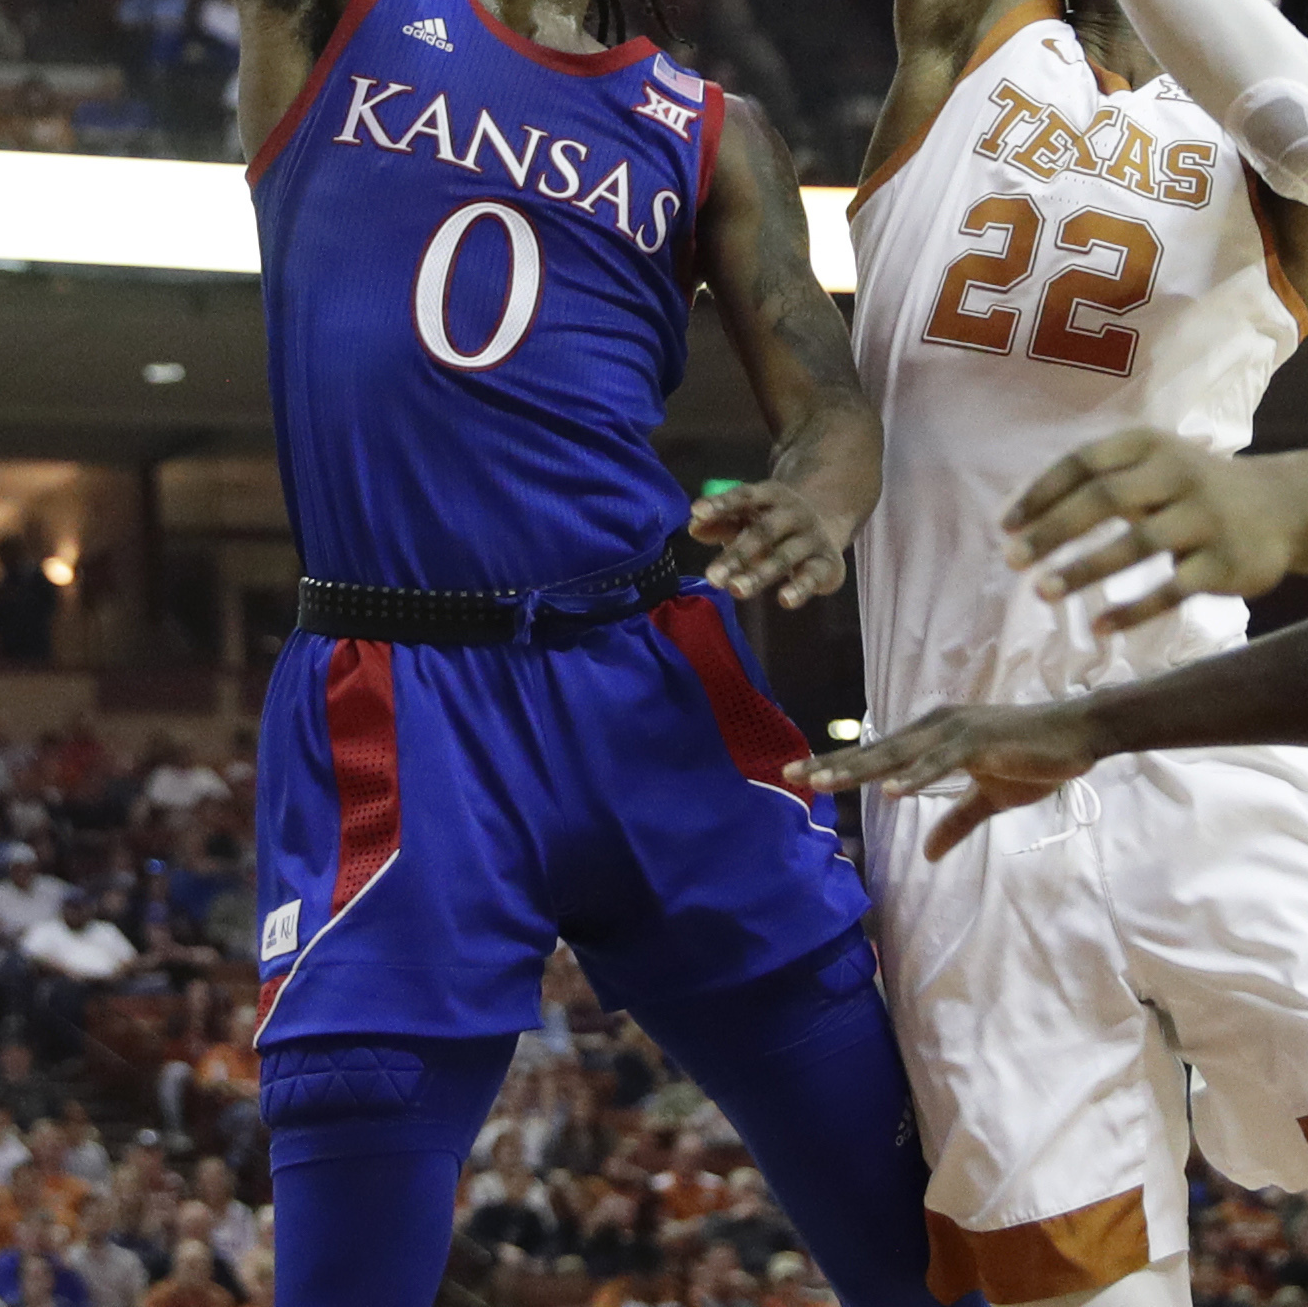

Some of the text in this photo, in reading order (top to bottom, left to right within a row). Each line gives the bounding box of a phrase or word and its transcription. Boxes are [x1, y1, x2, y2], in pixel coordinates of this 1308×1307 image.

[402, 24, 454, 53] adidas
[633, 80, 699, 142] XII
[332, 75, 683, 255] KANSAS
[974, 78, 1218, 210] TEXAS
[412, 197, 545, 374] 0
[922, 192, 1165, 378] 22
